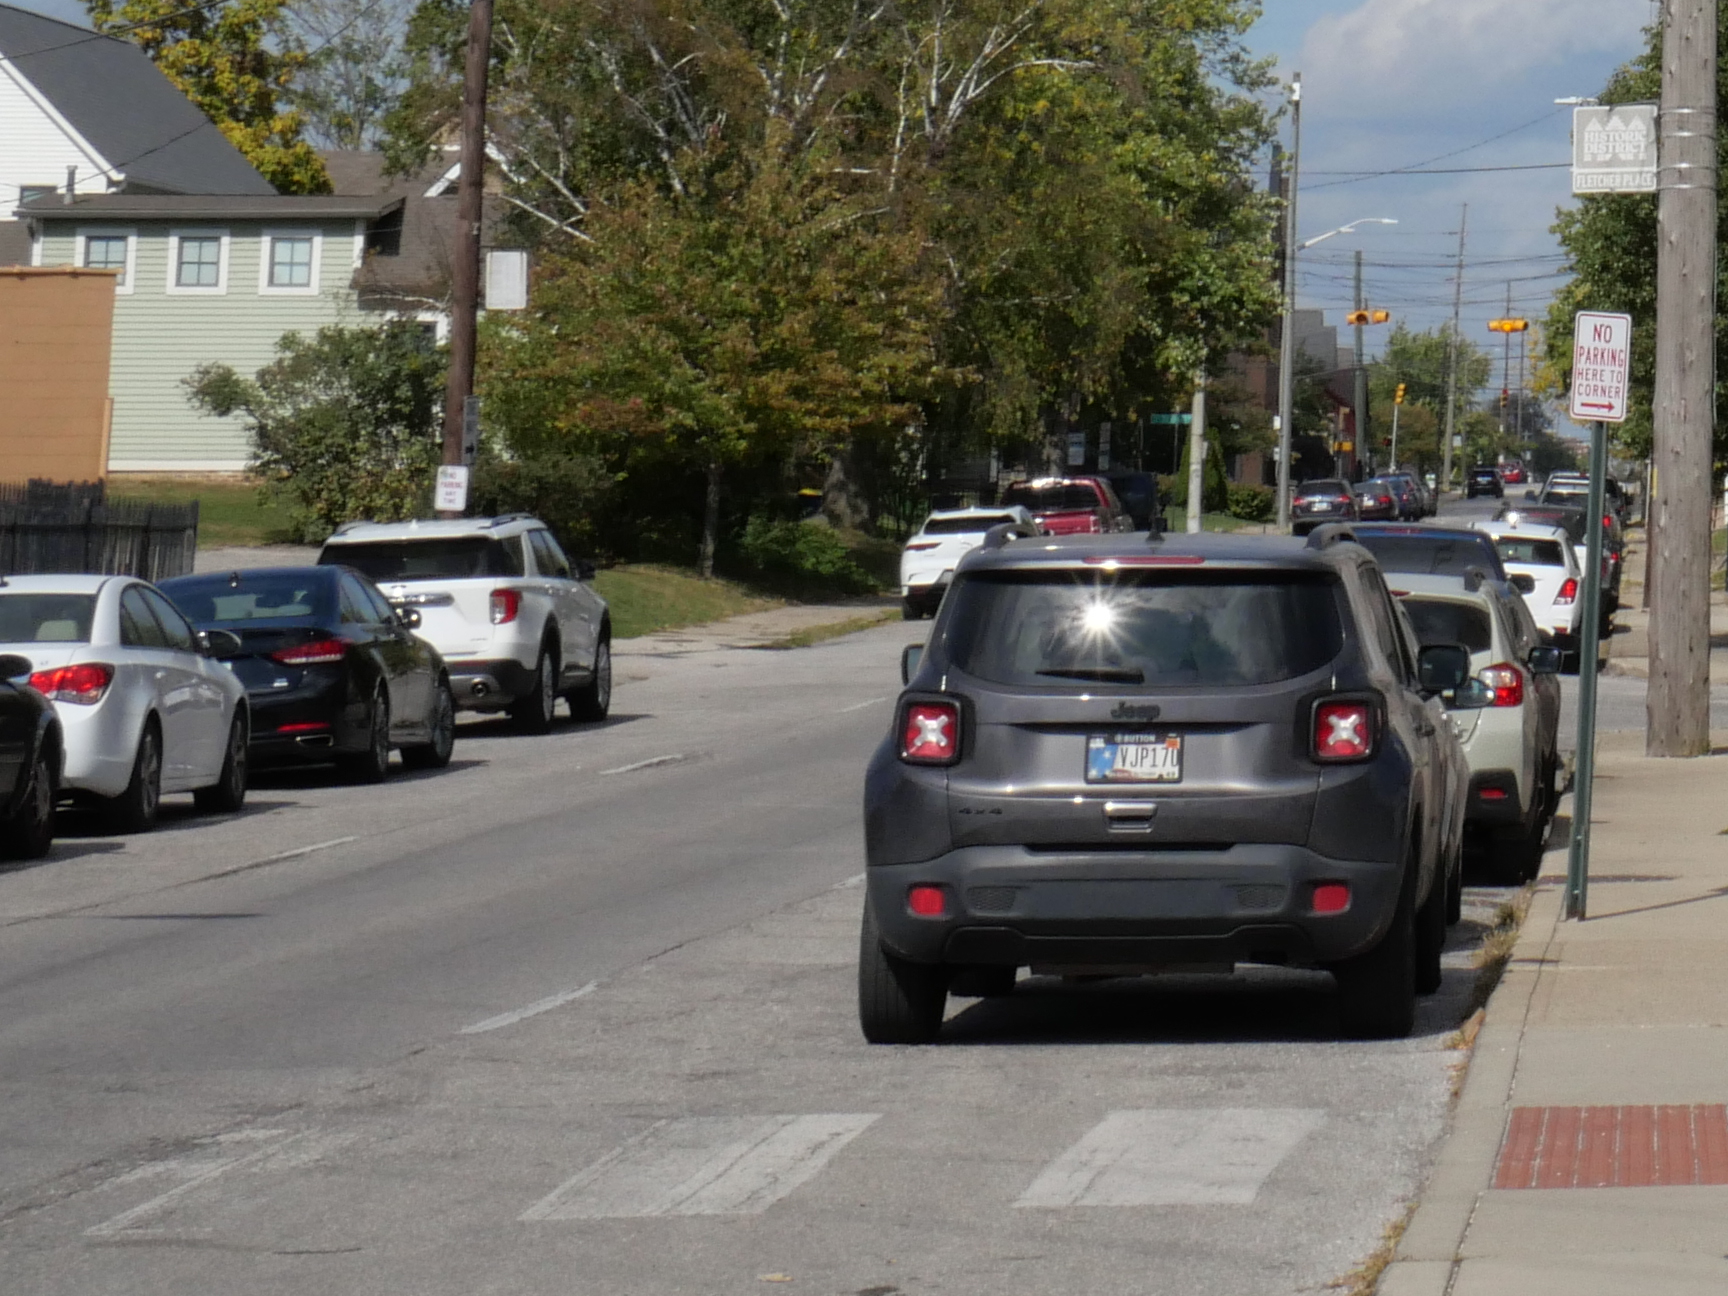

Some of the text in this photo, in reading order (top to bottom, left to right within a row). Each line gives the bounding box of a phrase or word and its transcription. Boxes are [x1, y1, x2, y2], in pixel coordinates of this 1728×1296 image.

[1584, 130, 1646, 142] HISTORIC
[1584, 142, 1646, 154] DISTRICT
[1576, 171, 1654, 188] FLETCHER PLACE
[1593, 323, 1613, 344] NO
[1577, 346, 1625, 367] PARKING
[1576, 368, 1623, 384] HERE TO
[1577, 383, 1621, 399] CORNER
[1110, 701, 1161, 723] Jeep
